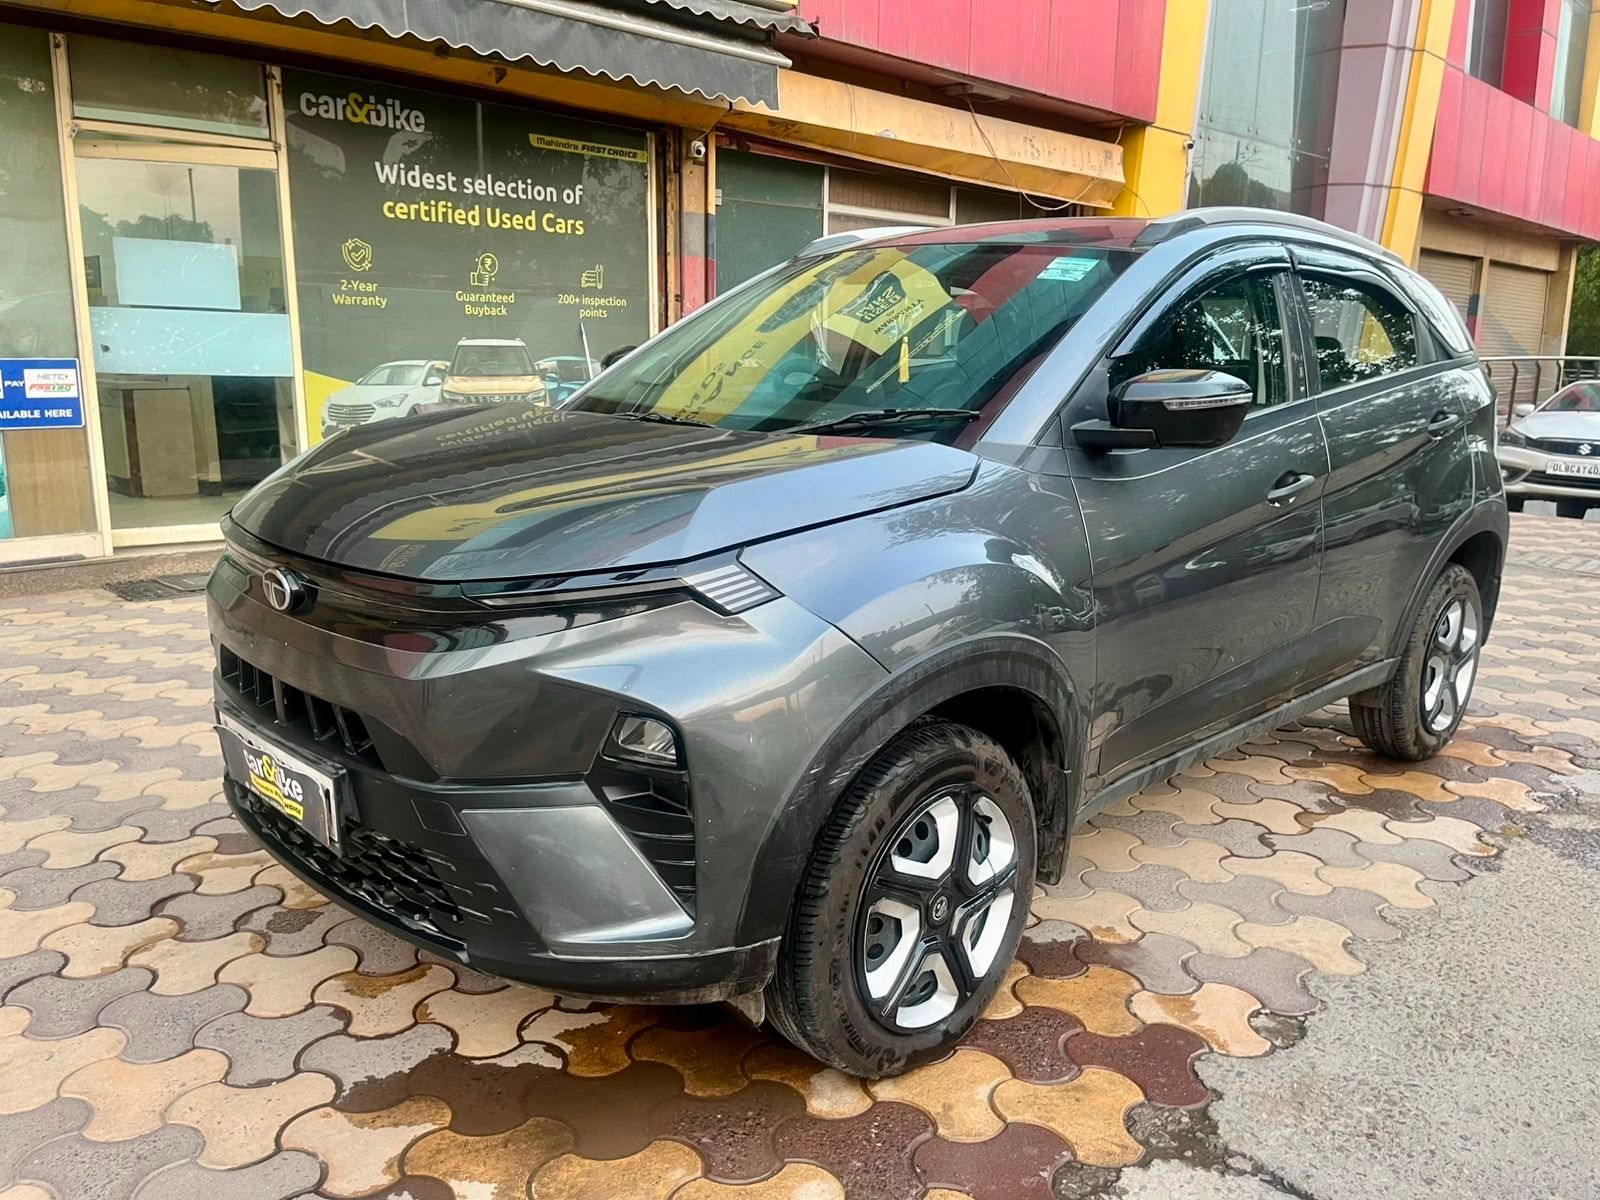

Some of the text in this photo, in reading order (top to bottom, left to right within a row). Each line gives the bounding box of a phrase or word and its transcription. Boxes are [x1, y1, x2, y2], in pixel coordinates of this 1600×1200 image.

[300, 92, 426, 133] car&bike
[536, 137, 638, 159] Mahindra FIRST CHOICE
[374, 160, 583, 205] Widest selection of
[383, 200, 585, 235] certified Used Cars
[340, 279, 378, 292] 2-Year
[332, 293, 388, 308] Warranty
[455, 290, 515, 304] Guaranteed
[558, 294, 627, 308] 200+ inspection
[465, 304, 508, 317] Buyback
[579, 306, 608, 319] points
[44, 409, 73, 418] HERE
